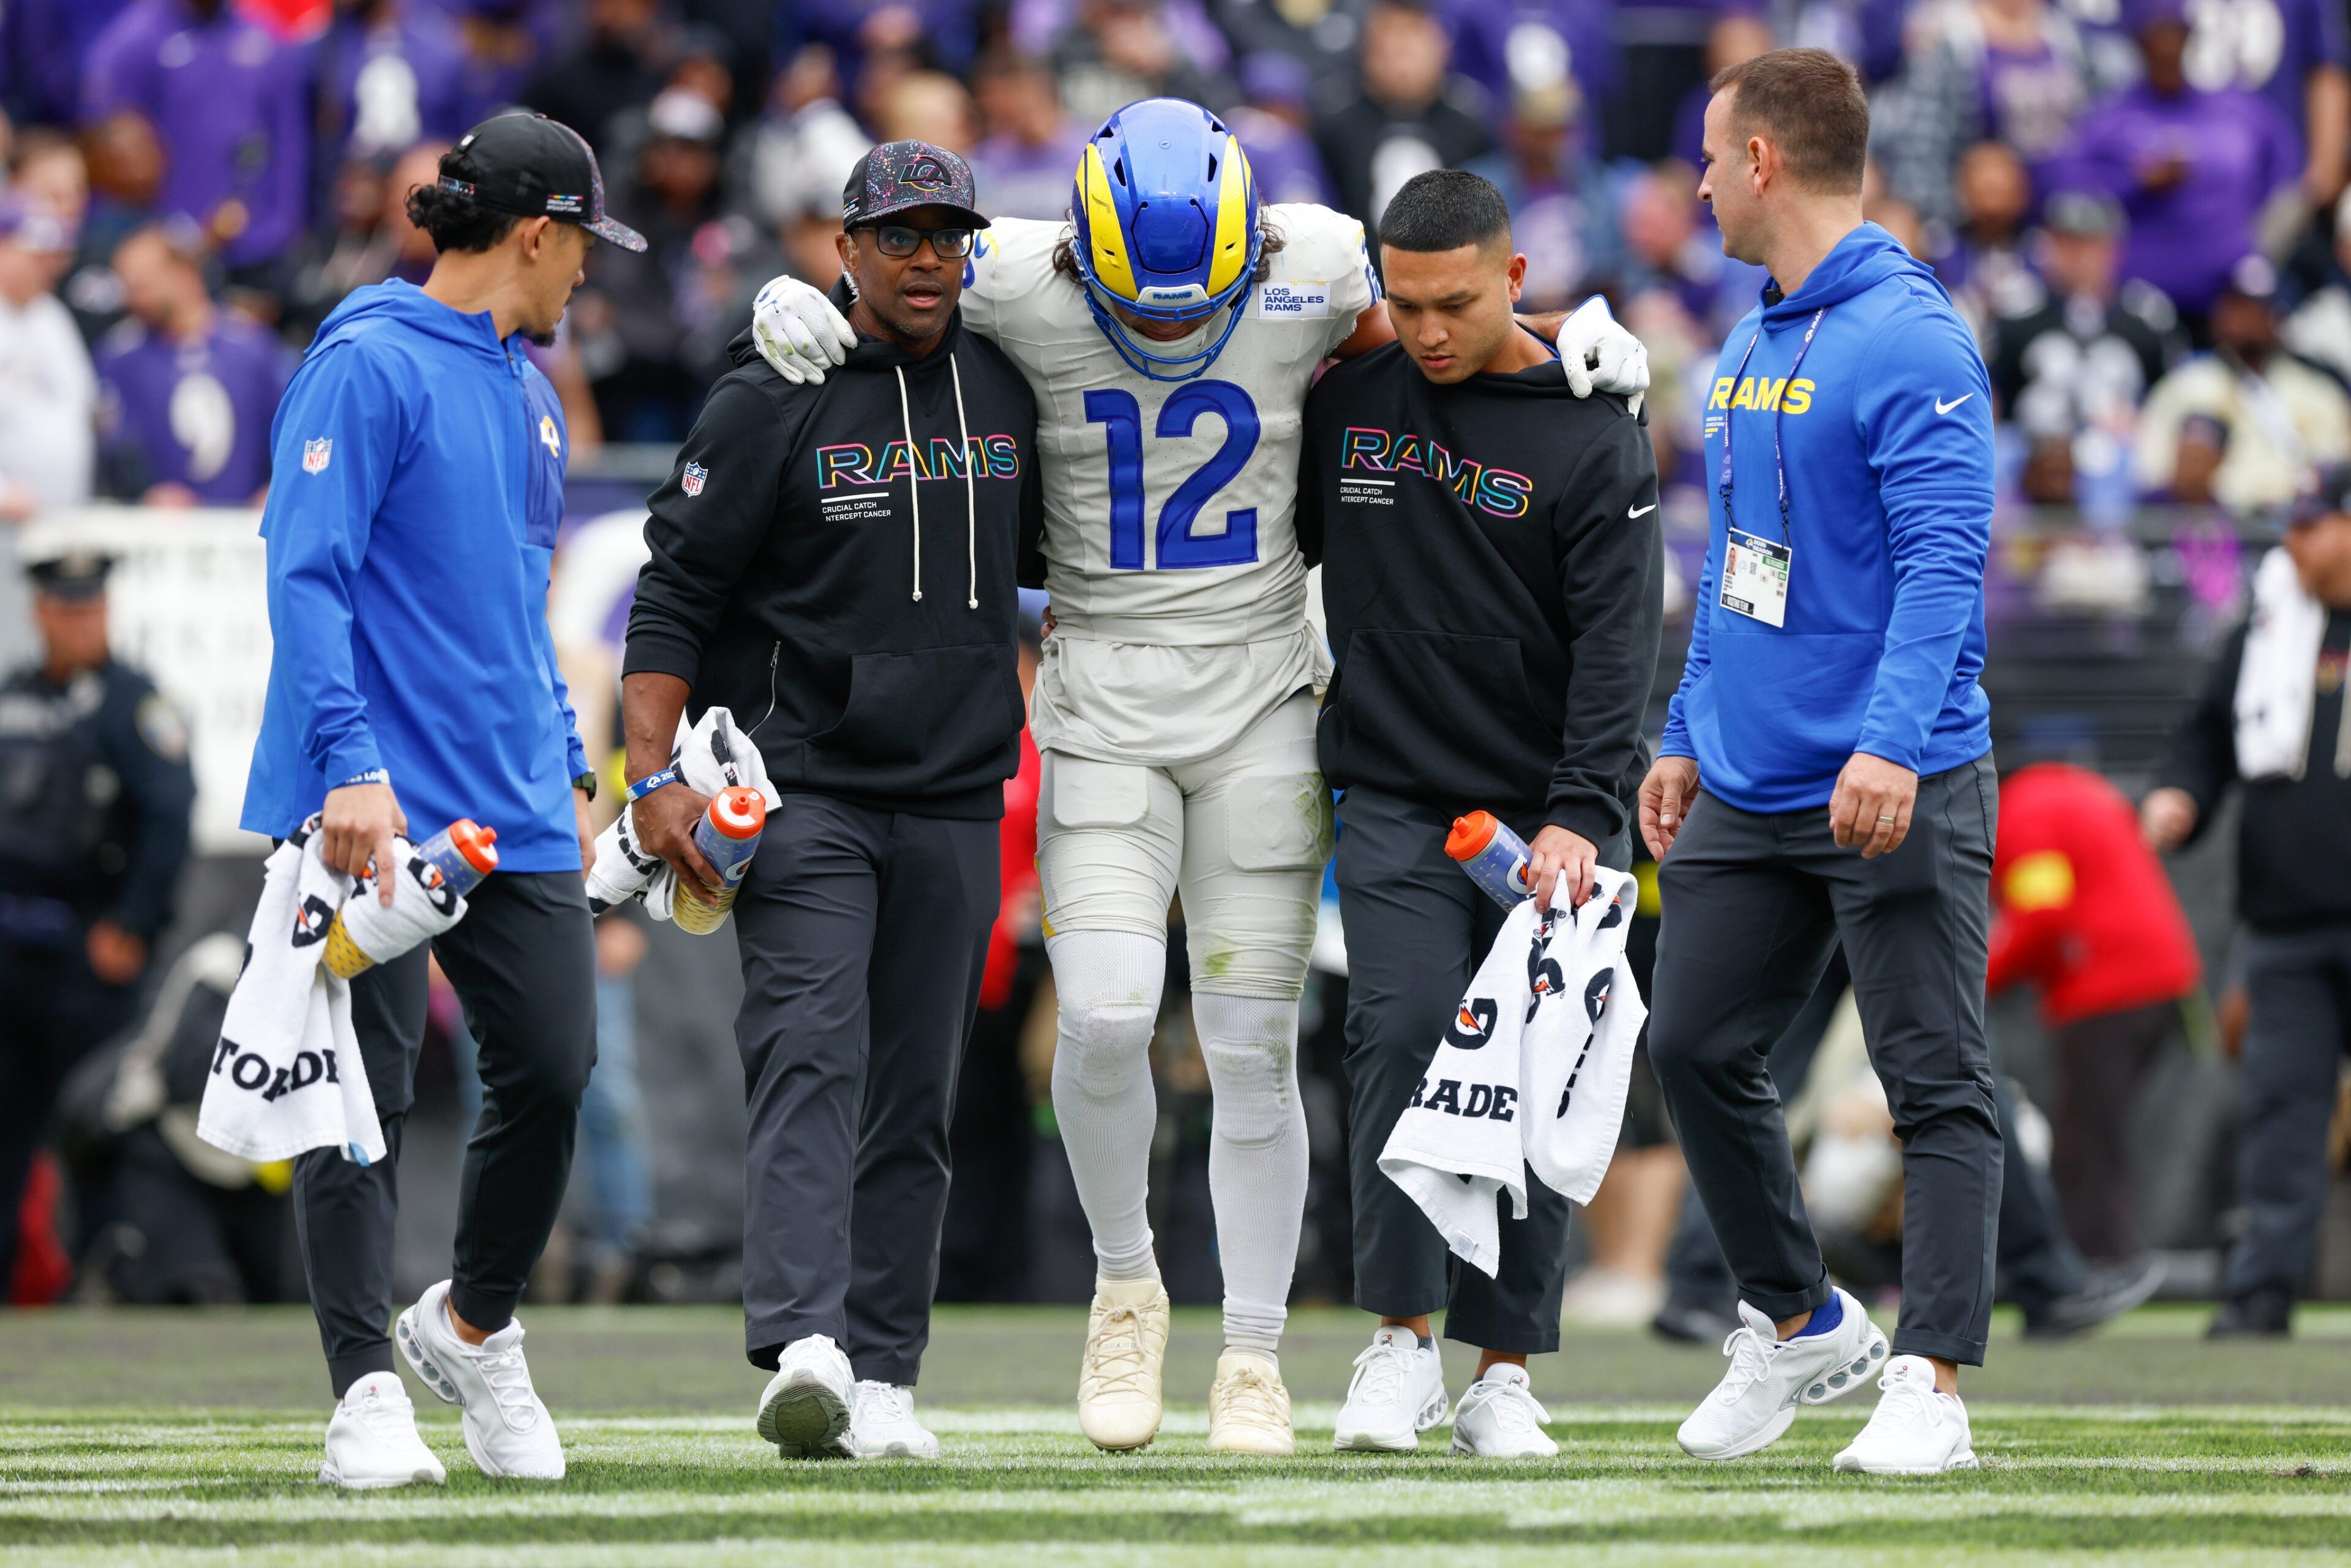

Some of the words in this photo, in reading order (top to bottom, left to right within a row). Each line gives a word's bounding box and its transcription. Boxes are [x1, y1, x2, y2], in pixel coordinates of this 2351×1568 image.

[1153, 290, 1193, 299] RAMS
[1811, 307, 1824, 329] RAM
[1708, 377, 1815, 415] RAMS
[307, 452, 328, 468] NFL
[816, 434, 1019, 489] RAMS
[684, 475, 702, 492] NFL
[1083, 380, 1261, 570] 12
[1342, 427, 1533, 518] RAMS
[822, 504, 853, 513] CRUCIAL
